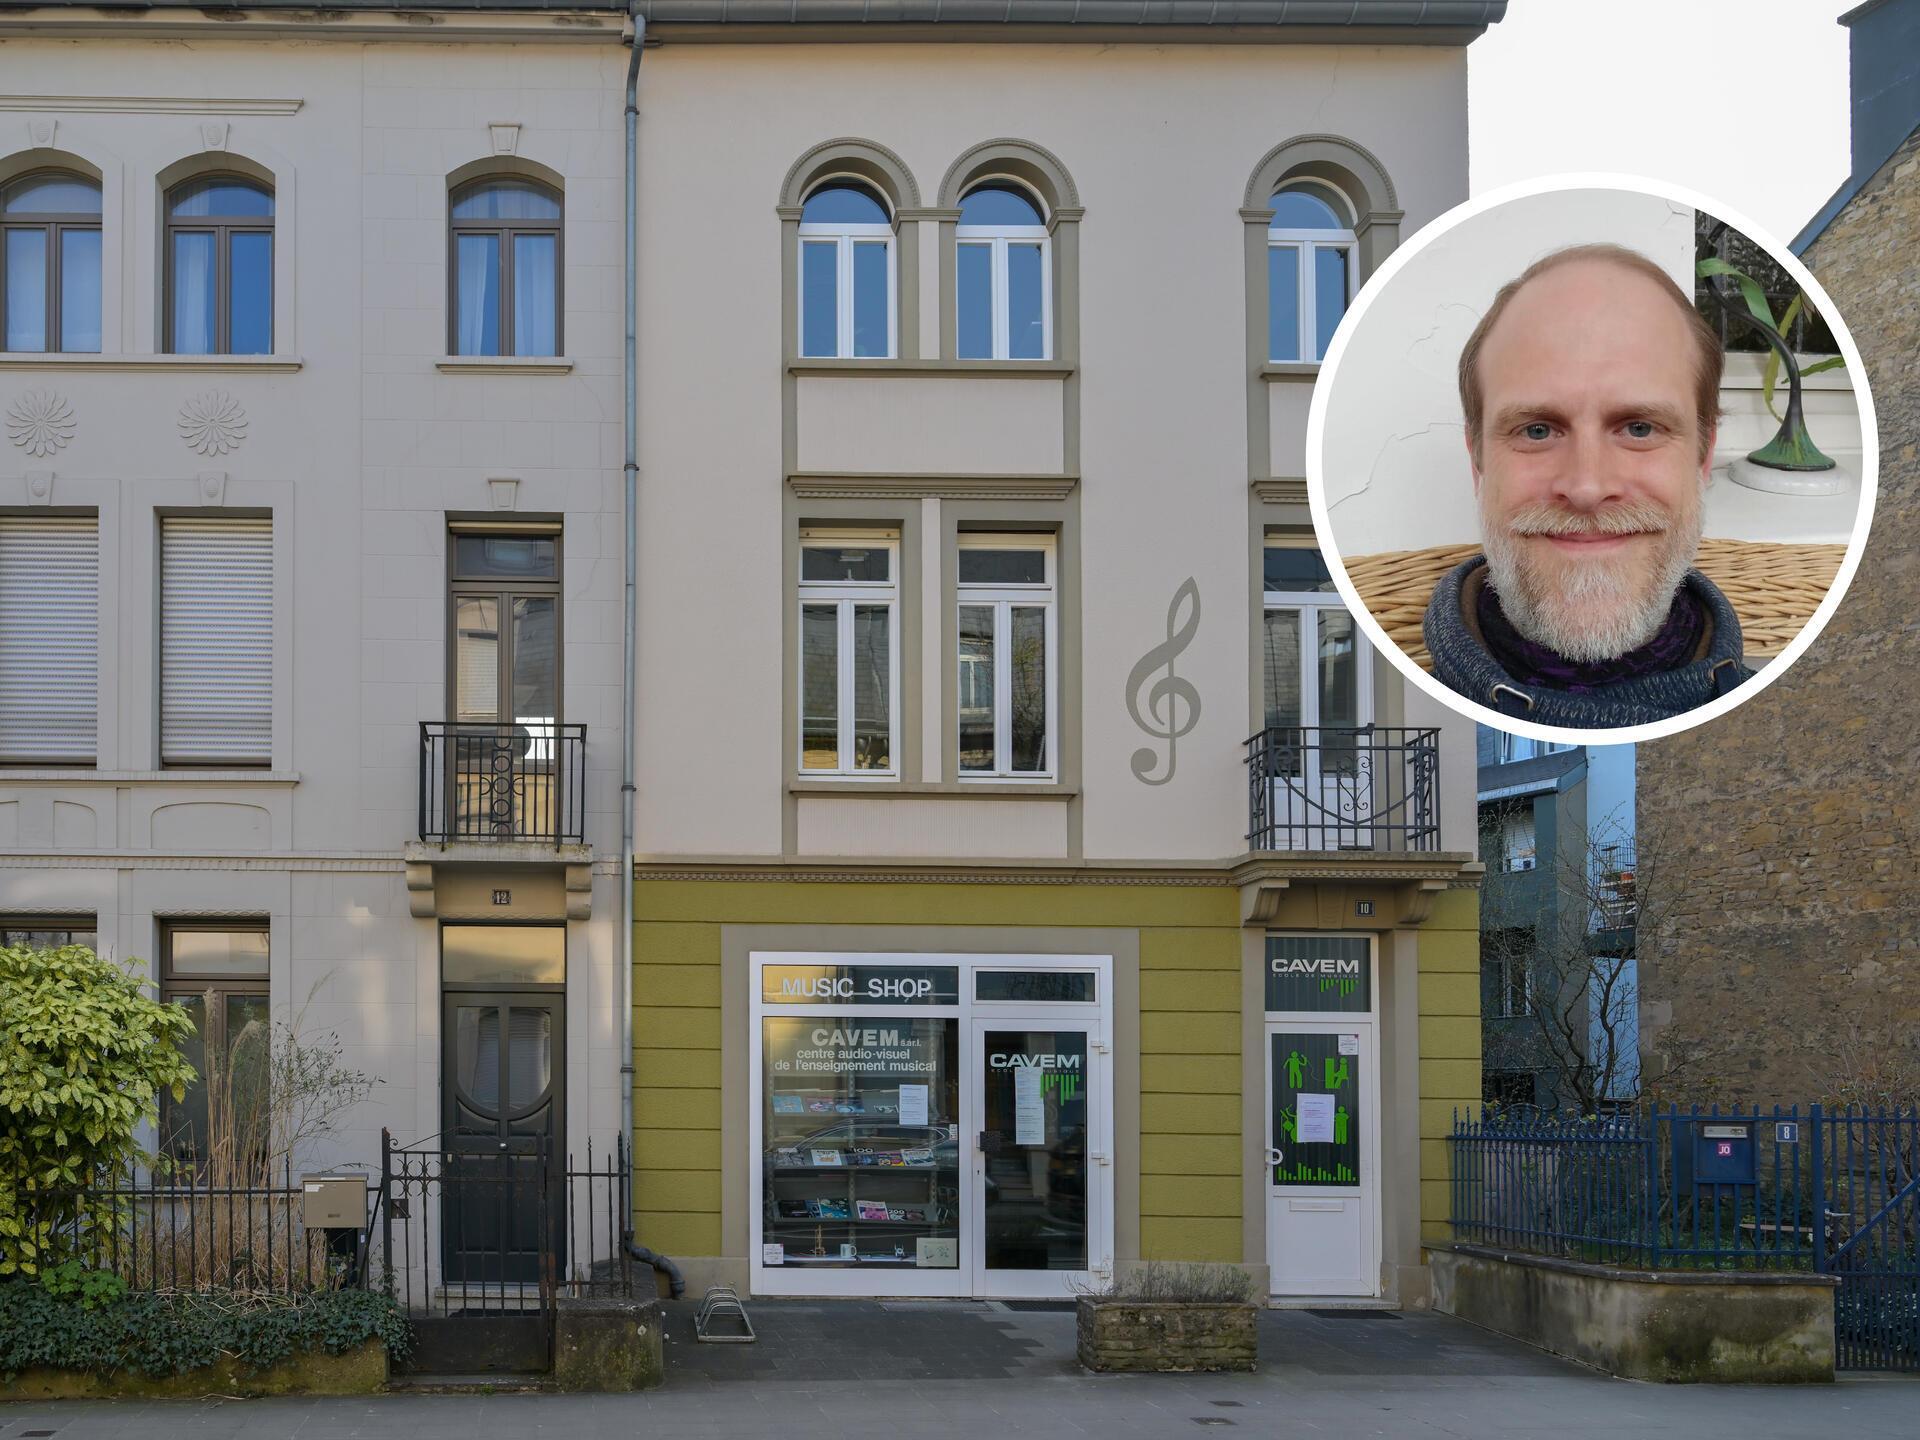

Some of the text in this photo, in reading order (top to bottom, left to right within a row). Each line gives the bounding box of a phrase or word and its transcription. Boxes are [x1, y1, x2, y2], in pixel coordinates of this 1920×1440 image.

[495, 891, 508, 904] 12
[1360, 903, 1369, 914] 10
[1271, 958, 1359, 973] CAVEM
[782, 977, 932, 998] MUSIC SHOP
[811, 1028, 899, 1047] CAVEM
[796, 1048, 835, 1059] centre
[775, 1060, 937, 1073] de l'enseignement musical
[989, 1053, 1080, 1068] CAVEM
[1783, 1126, 1790, 1139] 8
